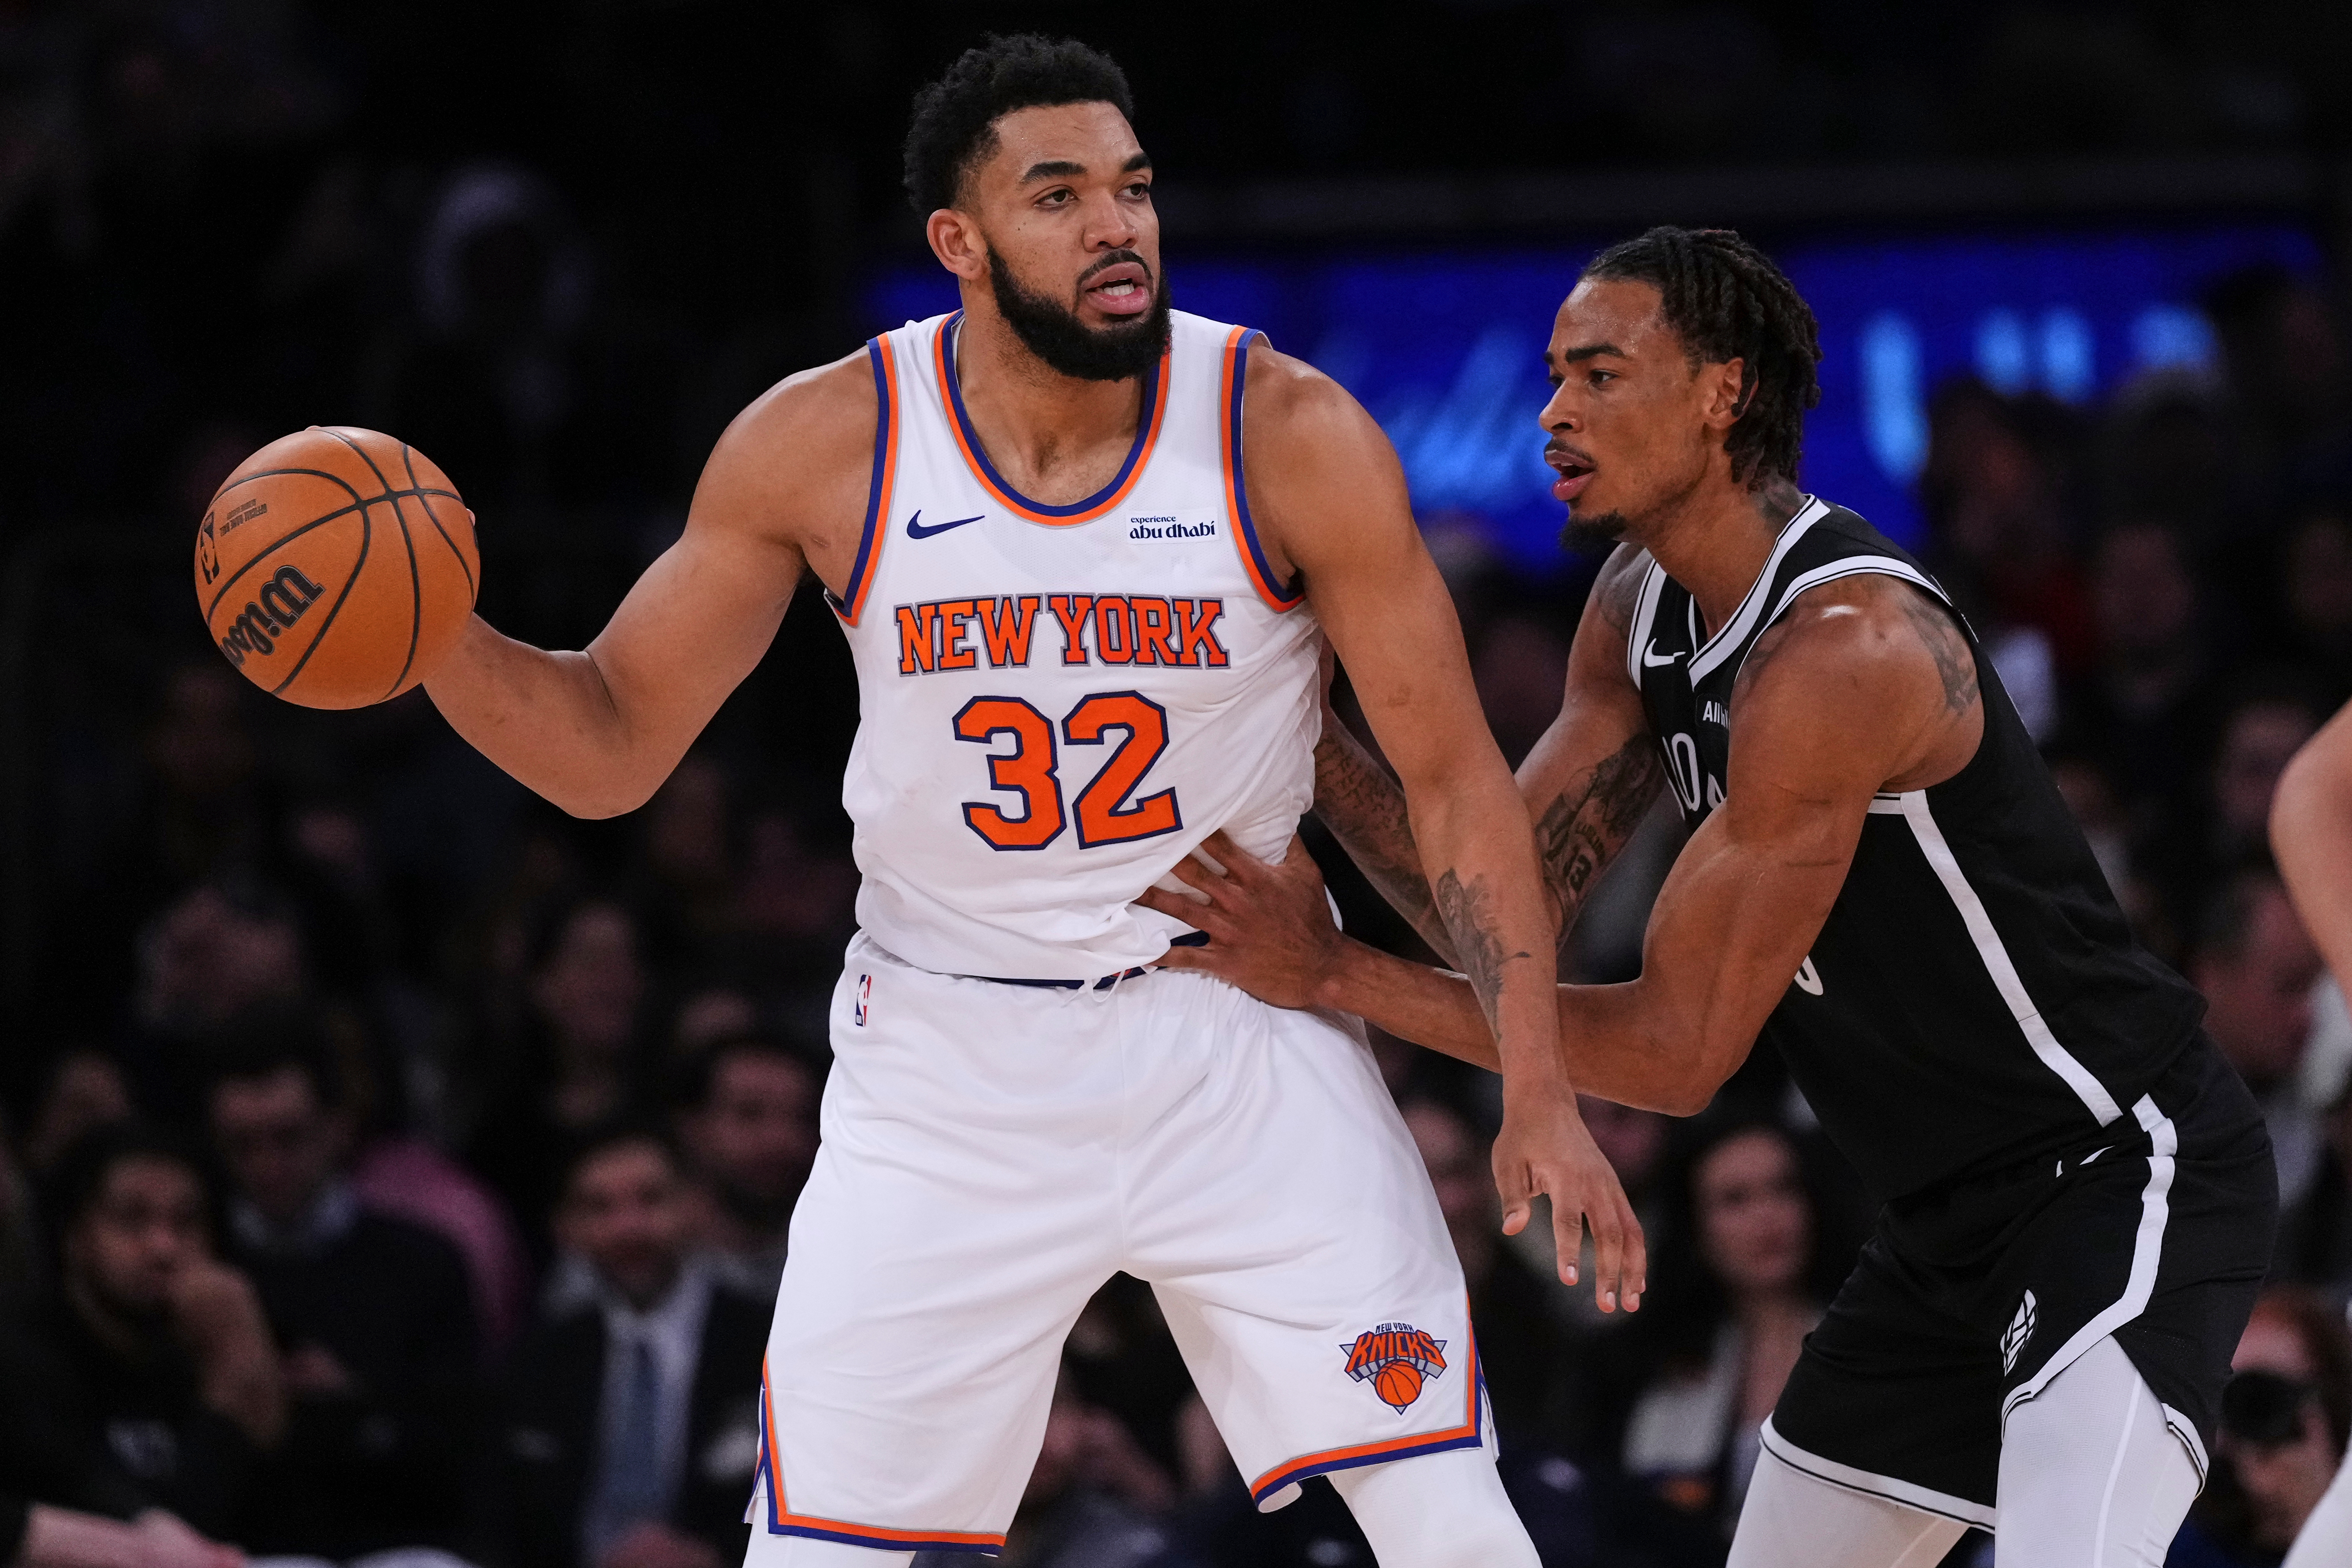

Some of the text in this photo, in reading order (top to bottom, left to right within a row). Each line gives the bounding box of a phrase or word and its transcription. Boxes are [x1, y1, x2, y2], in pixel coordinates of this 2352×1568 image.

[1130, 521, 1215, 539] abu dhabi
[1131, 516, 1176, 524] experience
[219, 565, 326, 666] Wilso
[894, 592, 1231, 676] NEW YORK
[952, 690, 1183, 851] 32
[1375, 1322, 1414, 1334] NEW YORK
[1344, 1330, 1447, 1376] KNICKS
